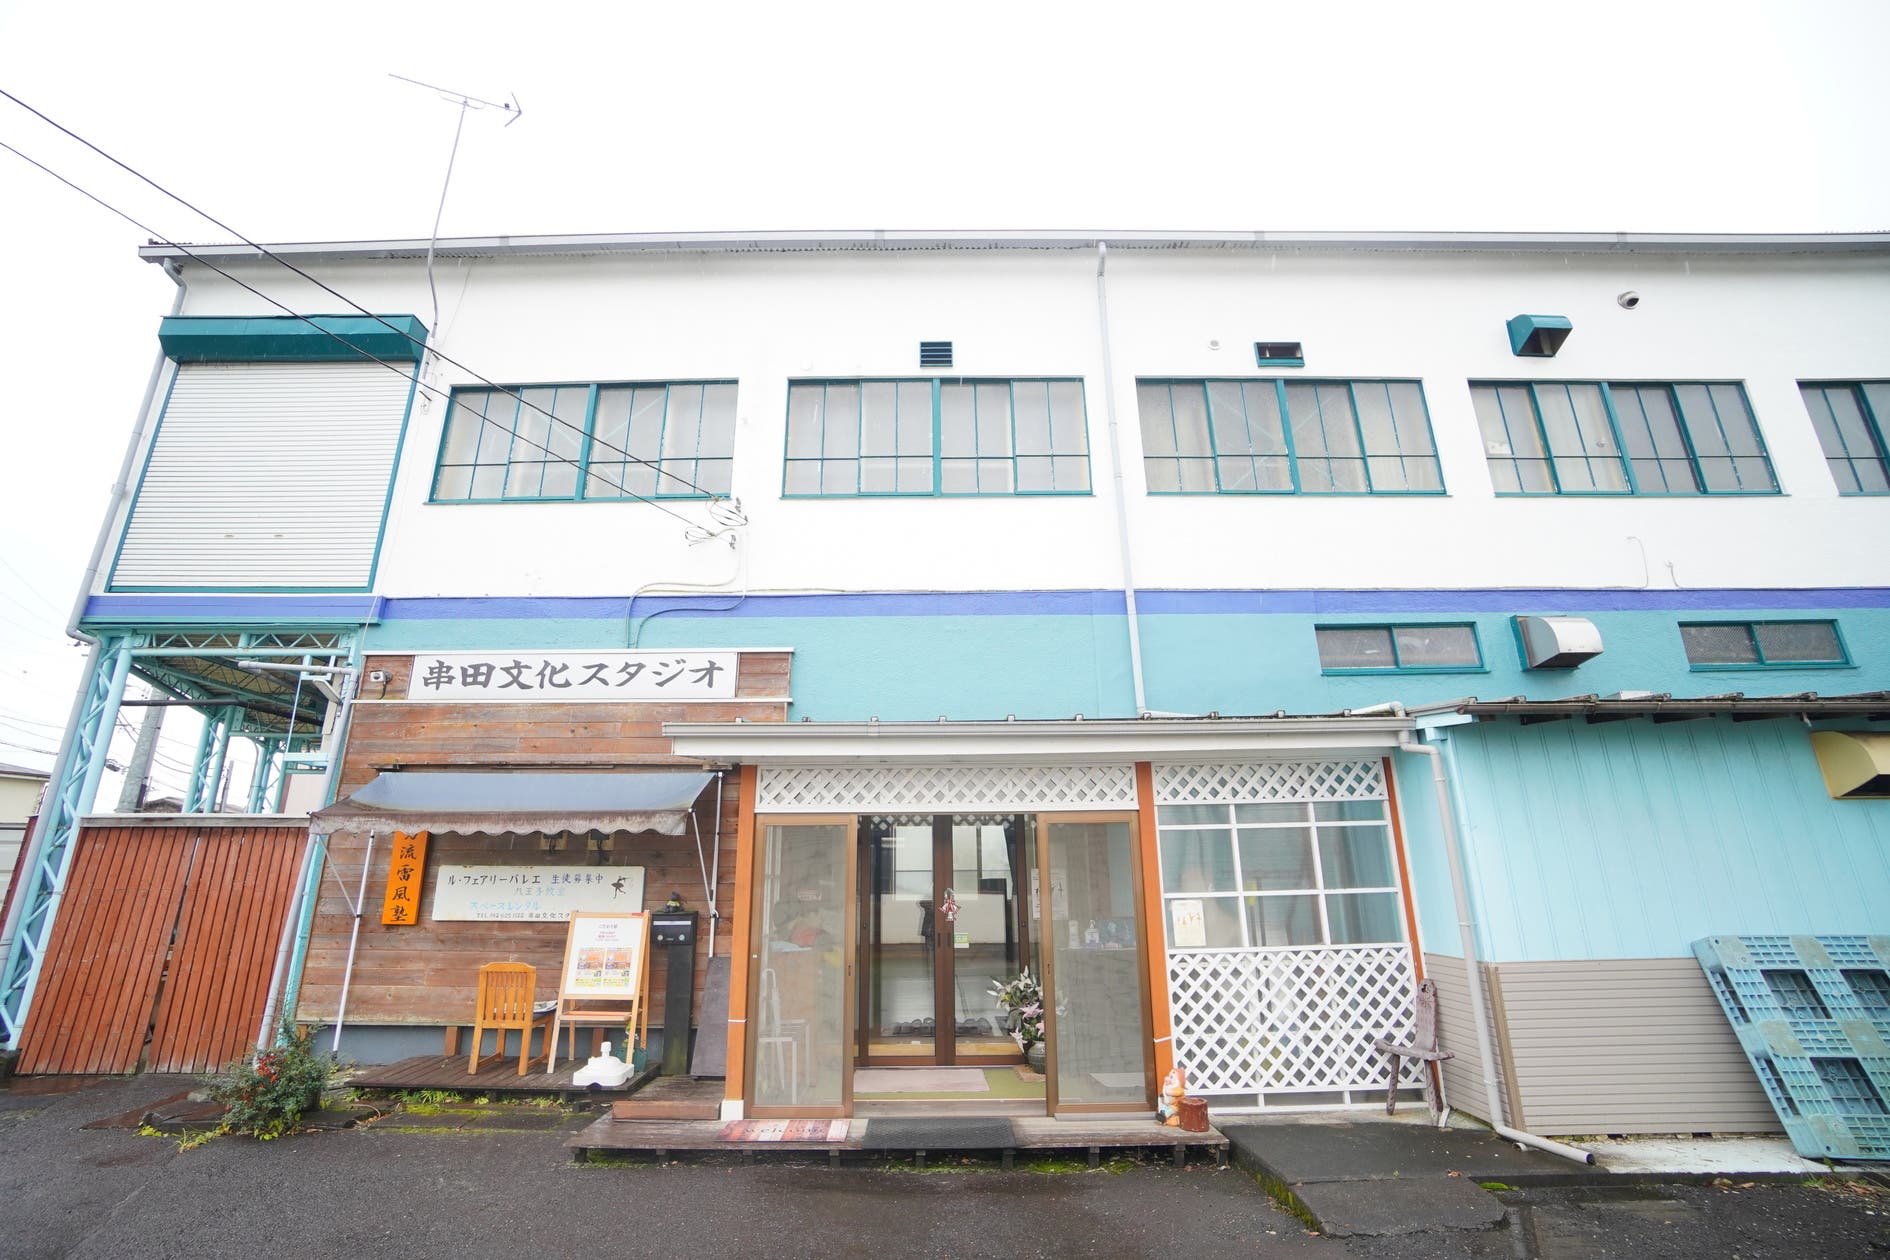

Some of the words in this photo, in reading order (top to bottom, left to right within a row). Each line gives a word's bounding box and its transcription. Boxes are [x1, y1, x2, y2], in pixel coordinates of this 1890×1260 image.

[422, 658, 724, 691] 串田文化スタジオ
[552, 873, 604, 885] 生徒募集中
